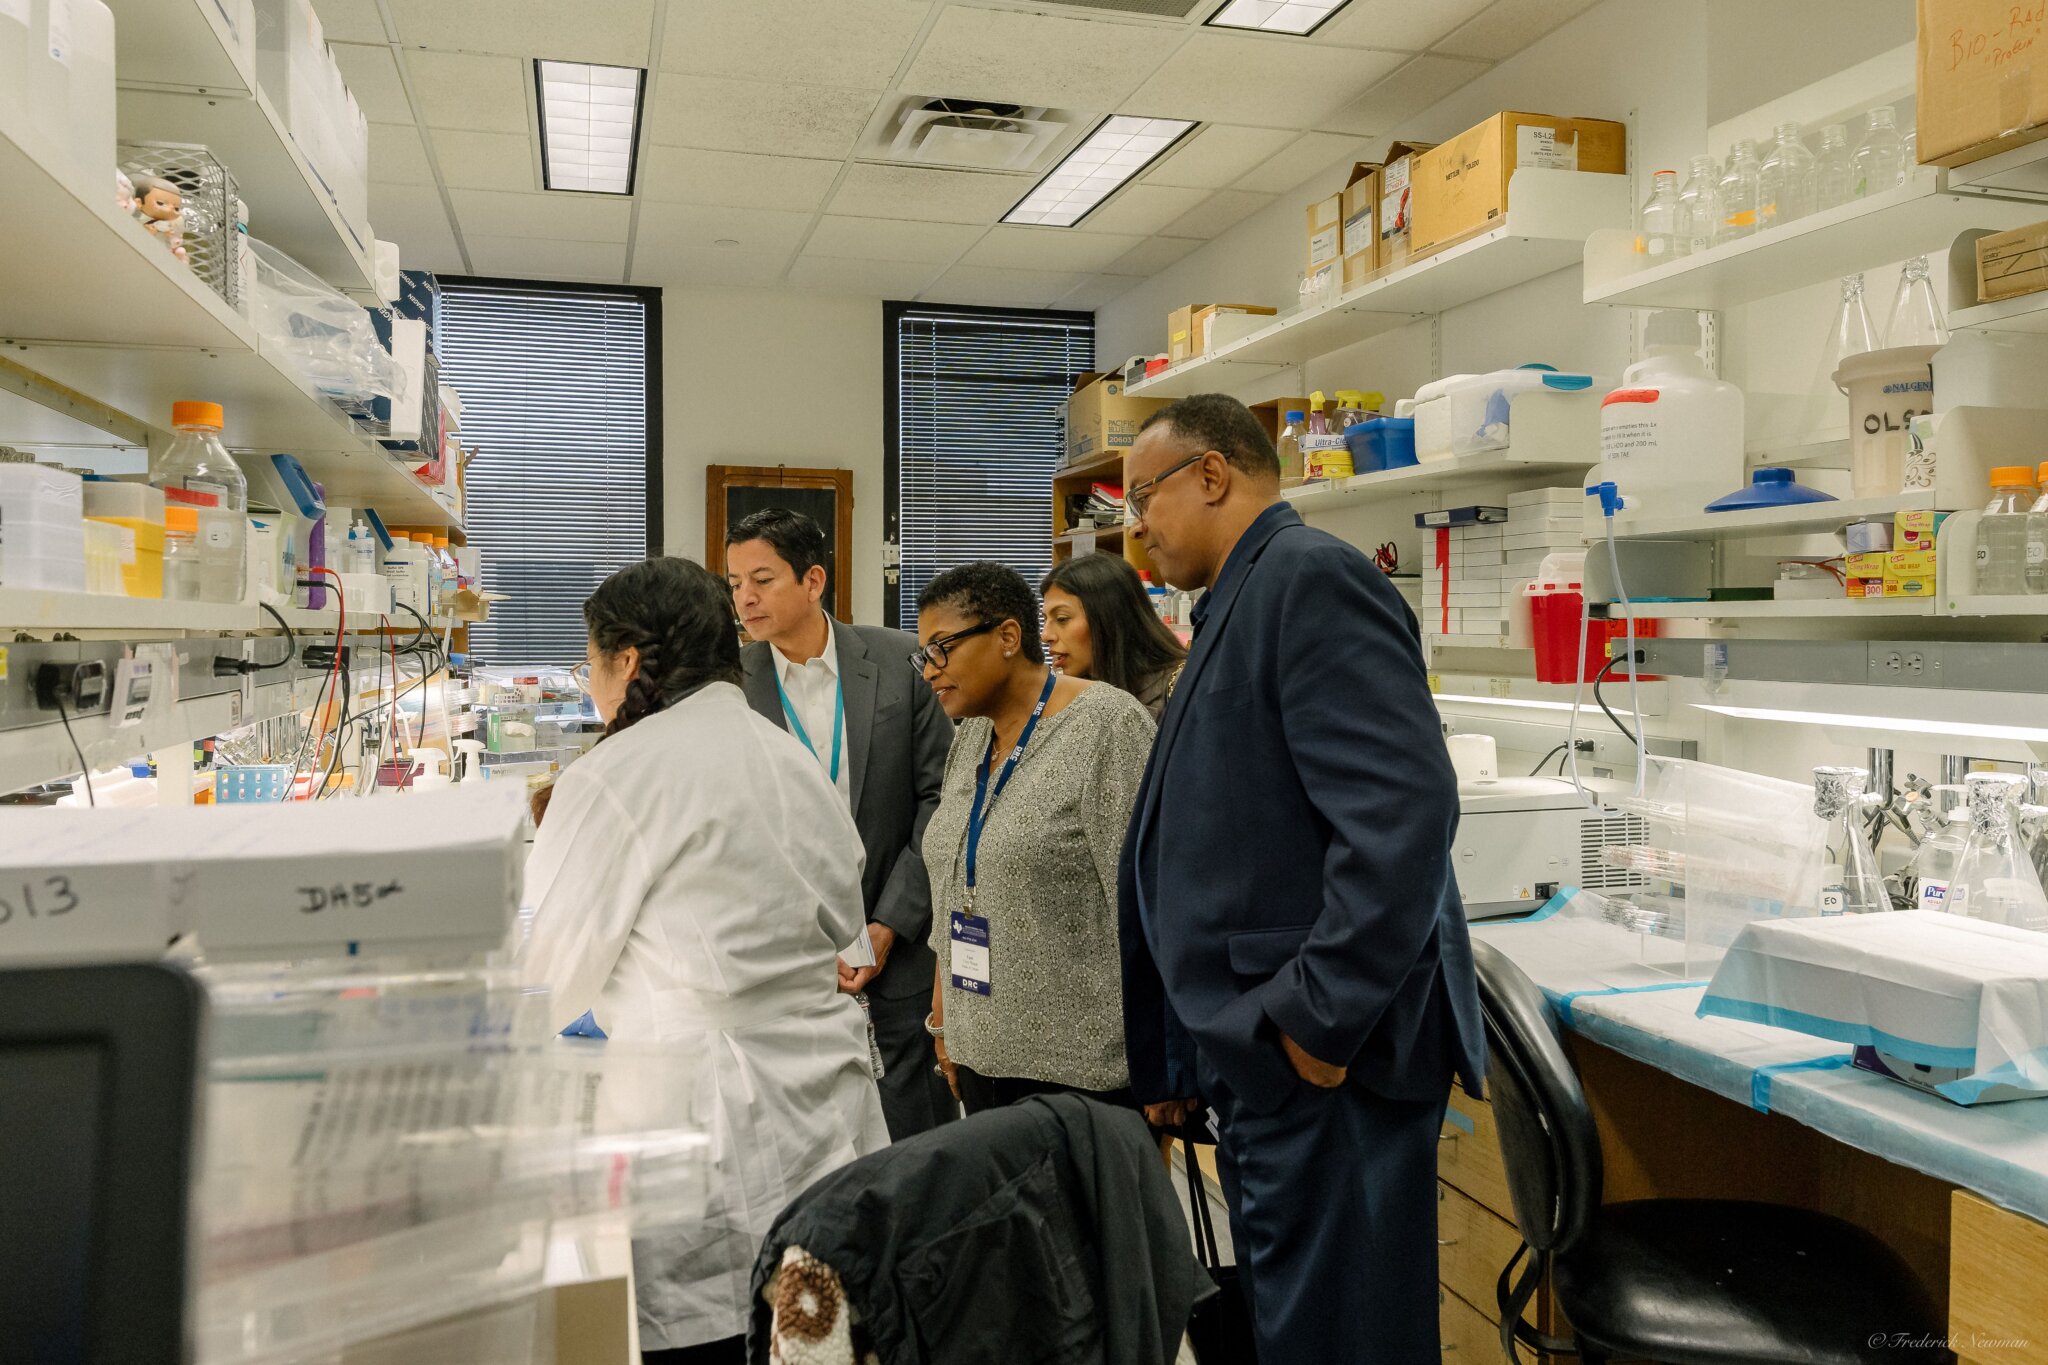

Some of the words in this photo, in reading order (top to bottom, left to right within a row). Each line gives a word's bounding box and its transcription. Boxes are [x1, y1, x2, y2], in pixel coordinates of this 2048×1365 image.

[1466, 159, 1479, 170] TOLEDO
[407, 293, 426, 312] QIAGEN
[1108, 419, 1135, 427] PACIFIC
[1866, 585, 1881, 595] 300
[1033, 701, 1046, 716] DRC
[1010, 745, 1023, 762] DRC
[962, 978, 978, 989] DRC
